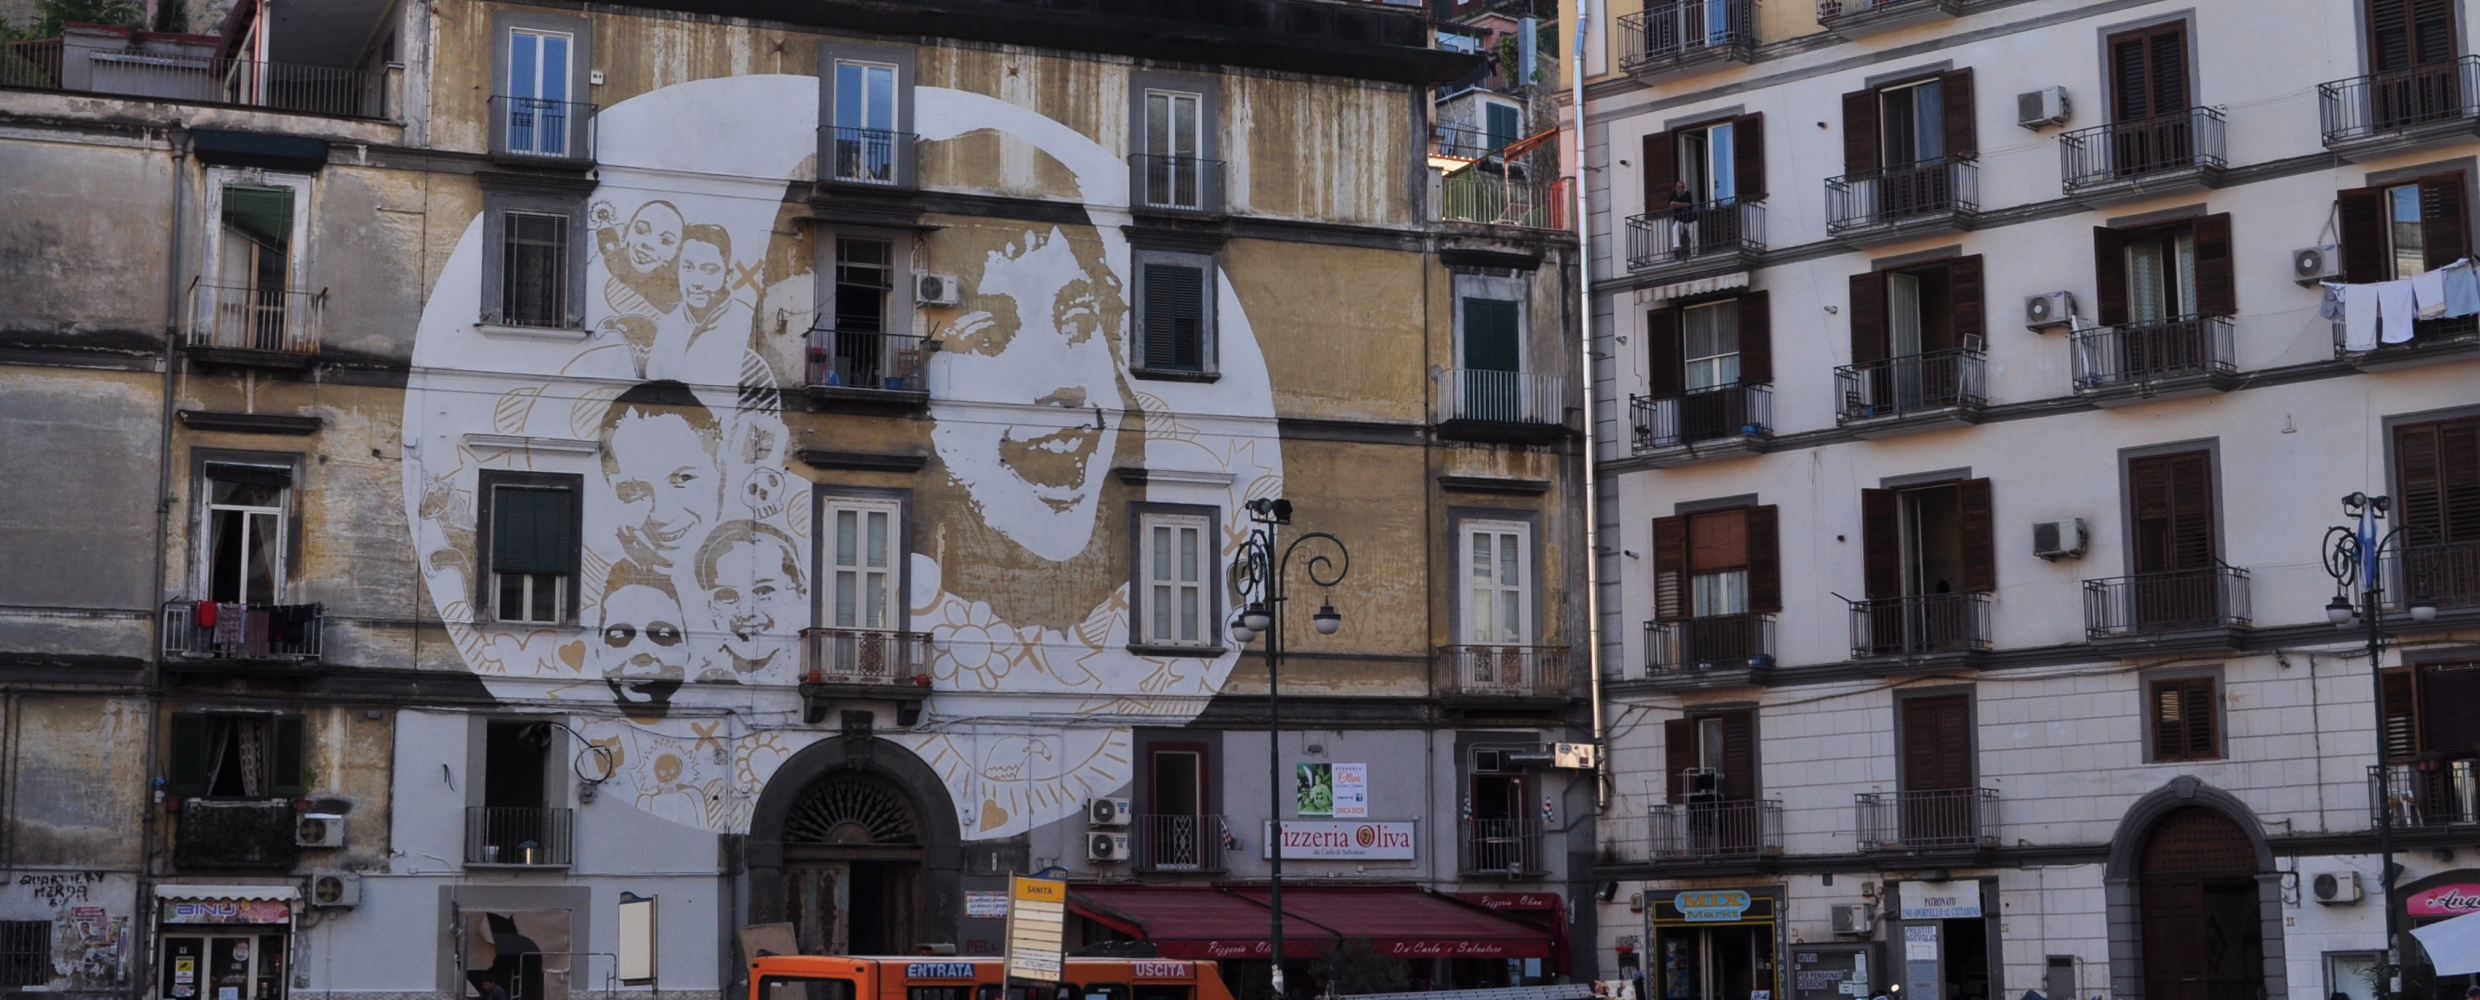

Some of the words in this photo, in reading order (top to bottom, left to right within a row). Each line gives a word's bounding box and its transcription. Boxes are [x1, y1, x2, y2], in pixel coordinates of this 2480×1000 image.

[1337, 770, 1361, 784] Oliva
[1352, 806, 1365, 814] SEDE
[1355, 824, 1410, 848] Oliva
[1048, 869, 1066, 879] anm
[34, 884, 88, 899] MERDA
[1481, 895, 1513, 909] Pizzeria
[1519, 894, 1543, 906] Oliva
[1681, 893, 1744, 908] MIX
[1924, 897, 1956, 907] PATRONATO
[176, 903, 236, 916] BINU
[1686, 909, 1739, 919] Markt
[1902, 908, 1913, 918] UNO
[1914, 908, 1943, 918] SPORTELLO
[1943, 908, 1951, 917] AL
[1951, 907, 1980, 917] CITTADINO
[1906, 926, 1934, 935] PRESTITI
[1208, 940, 1247, 957] Pizzeria
[1255, 940, 1274, 954] Oli
[1393, 942, 1410, 953] Da
[1413, 941, 1441, 953] Carla
[1457, 941, 1503, 954] Salvatore
[908, 963, 973, 977] ENTRATA
[1135, 963, 1185, 977] USCITA
